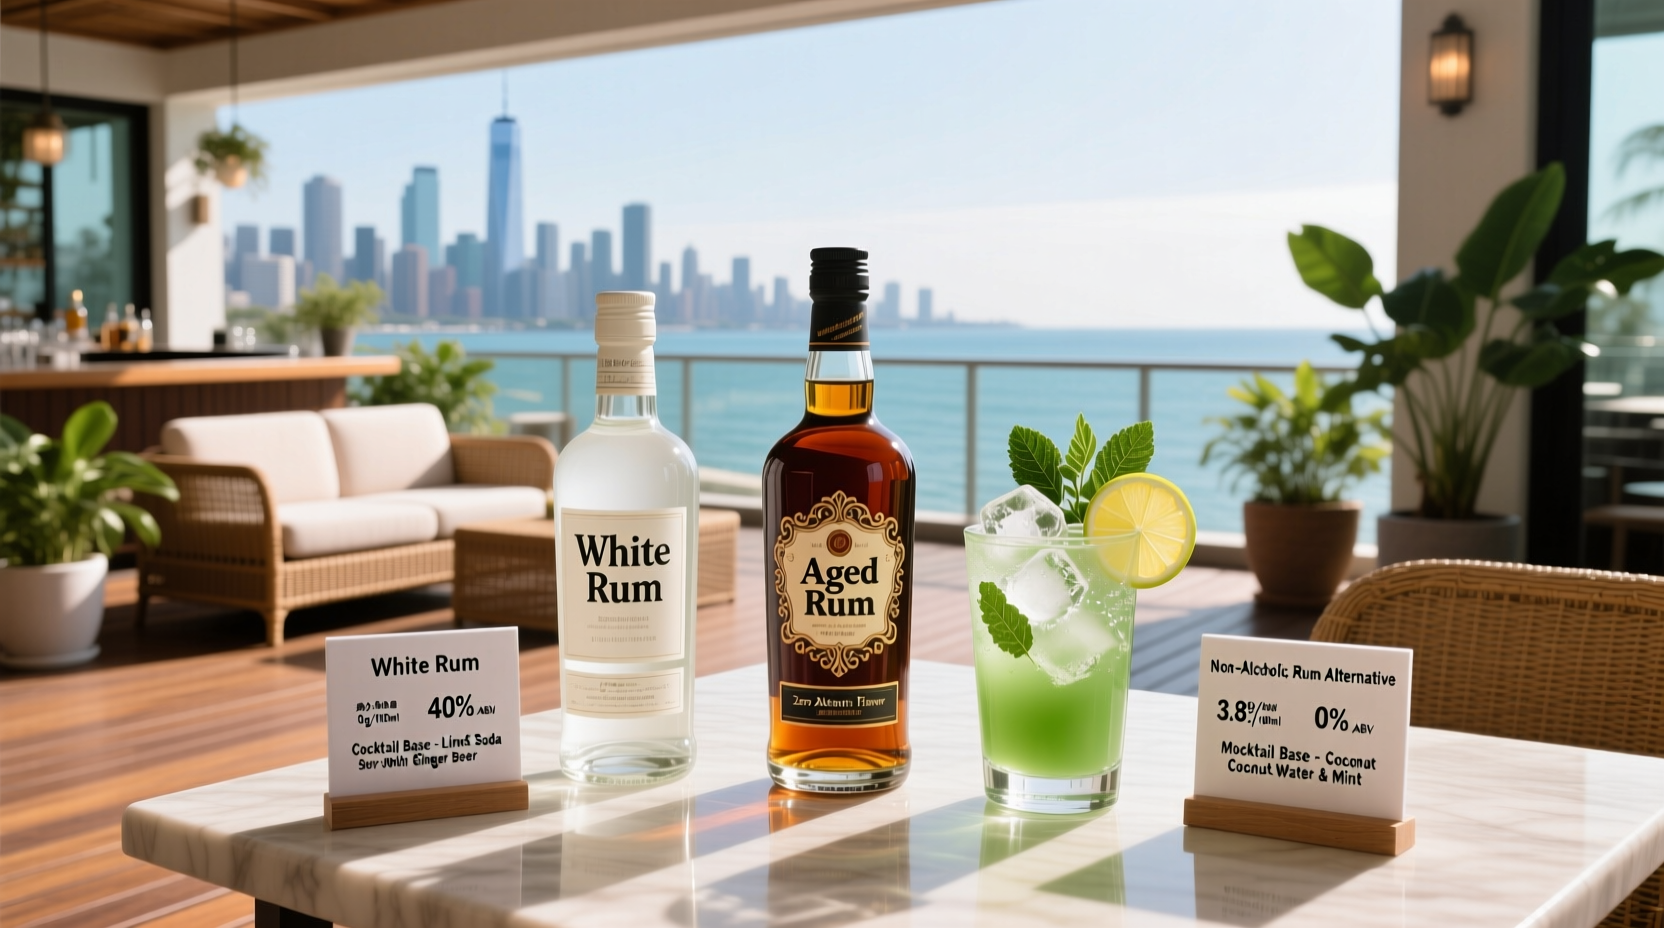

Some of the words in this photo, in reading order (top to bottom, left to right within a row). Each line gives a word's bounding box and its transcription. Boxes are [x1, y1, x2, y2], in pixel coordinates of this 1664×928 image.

[574, 534, 671, 567] White
[586, 571, 663, 604] Rum
[800, 556, 879, 595] Aged
[804, 589, 876, 617] Rum
[371, 656, 430, 677] White
[435, 654, 480, 673] Rum
[1292, 665, 1321, 680] Rum
[1324, 667, 1396, 686] Alternative
[427, 694, 474, 719] 40%
[1314, 706, 1349, 731] 0%
[1352, 723, 1374, 734] ABV
[351, 740, 399, 756] Cocktail
[403, 739, 431, 752] Base
[474, 732, 502, 746] Soda
[1221, 740, 1275, 759] Mocktail
[1279, 746, 1311, 762] Base
[412, 752, 449, 769] Ginger
[451, 751, 478, 763] Beer
[1276, 763, 1315, 780] Water
[1318, 767, 1328, 782] &
[1332, 769, 1362, 786] Mint
